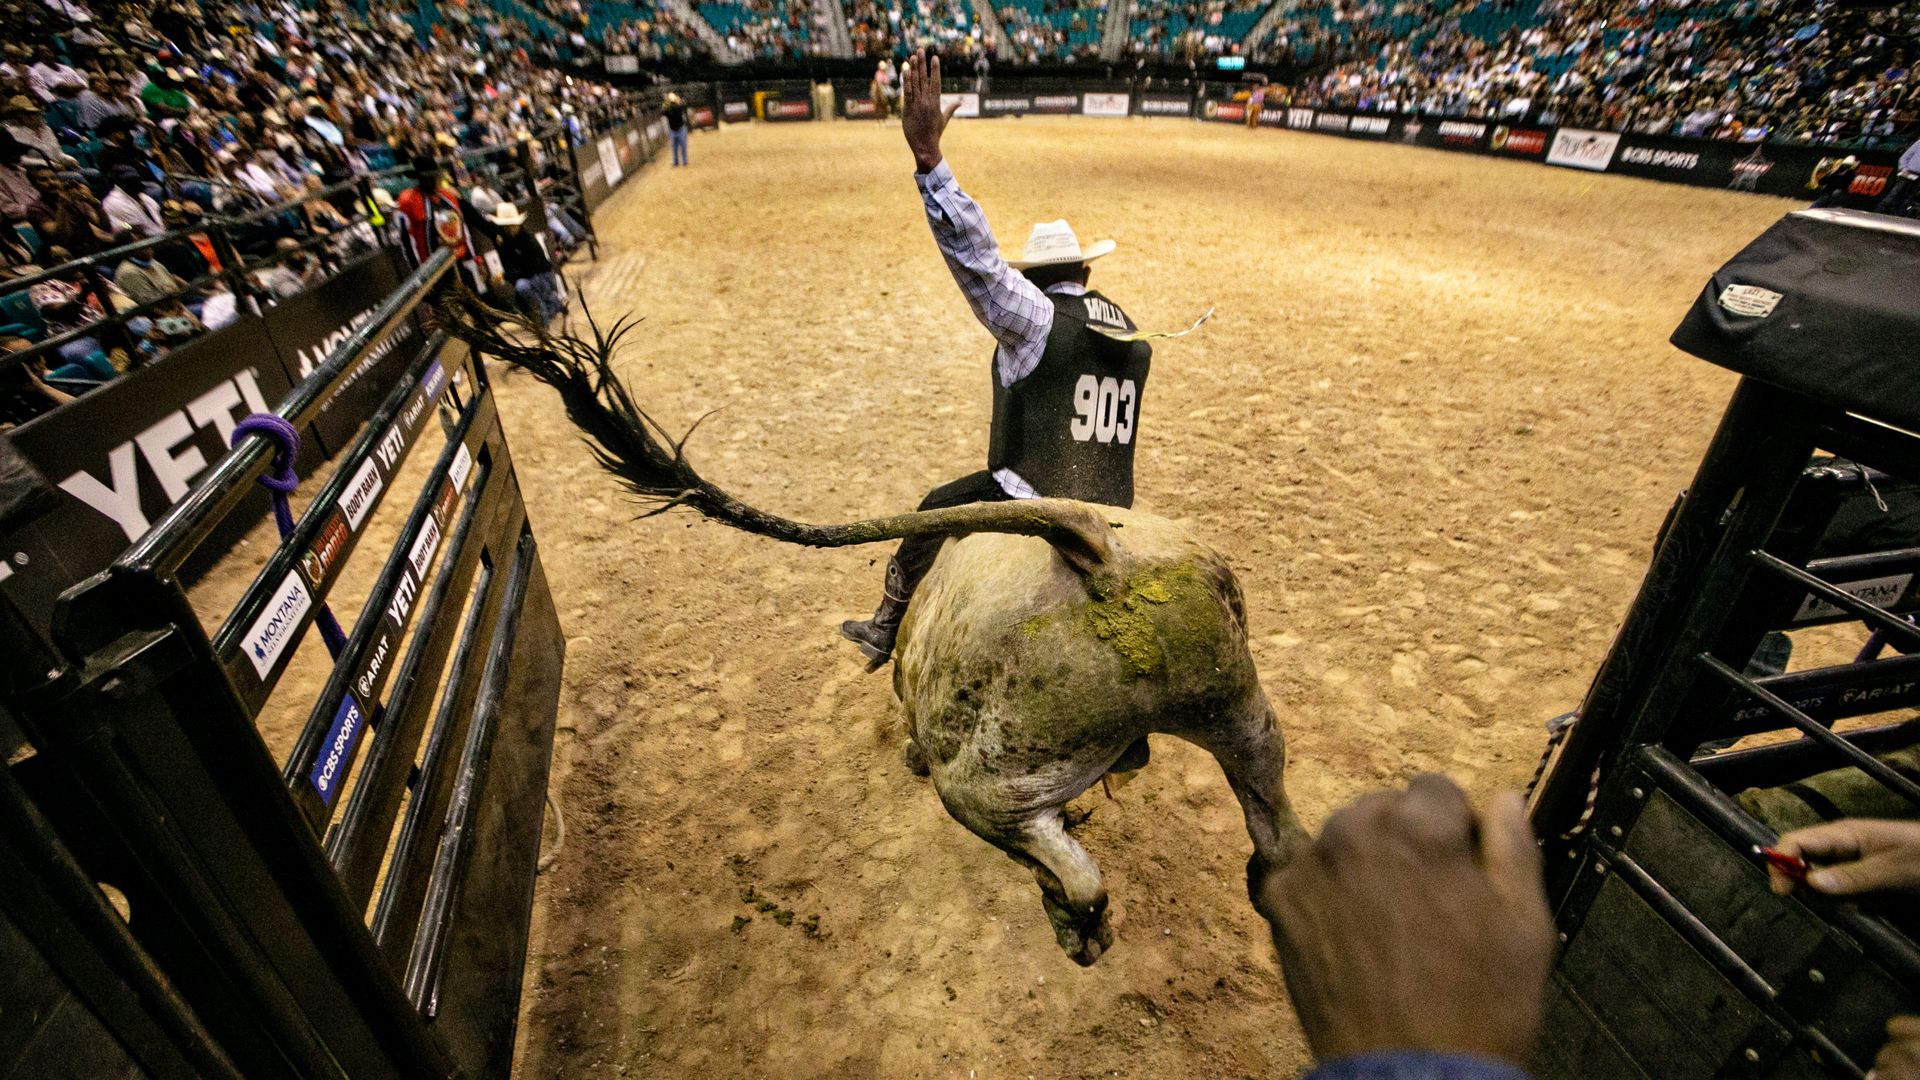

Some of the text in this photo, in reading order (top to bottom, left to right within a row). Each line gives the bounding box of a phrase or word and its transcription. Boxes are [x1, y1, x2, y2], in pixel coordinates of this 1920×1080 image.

[1287, 108, 1314, 129] YETI
[1632, 147, 1653, 165] CBS
[1651, 149, 1699, 170] SPORTS
[1848, 175, 1888, 196] DEO
[1070, 374, 1136, 445] 903
[57, 366, 272, 544] YETI
[376, 424, 405, 471] YETI
[345, 467, 379, 520] BOOT BARN
[260, 585, 302, 648] MONTANA
[387, 569, 417, 627] YETI
[1850, 584, 1898, 599] NTANA
[367, 635, 389, 686] ARIAT
[1854, 683, 1916, 701] ARIAT
[323, 705, 360, 780] CBS SPORTS
